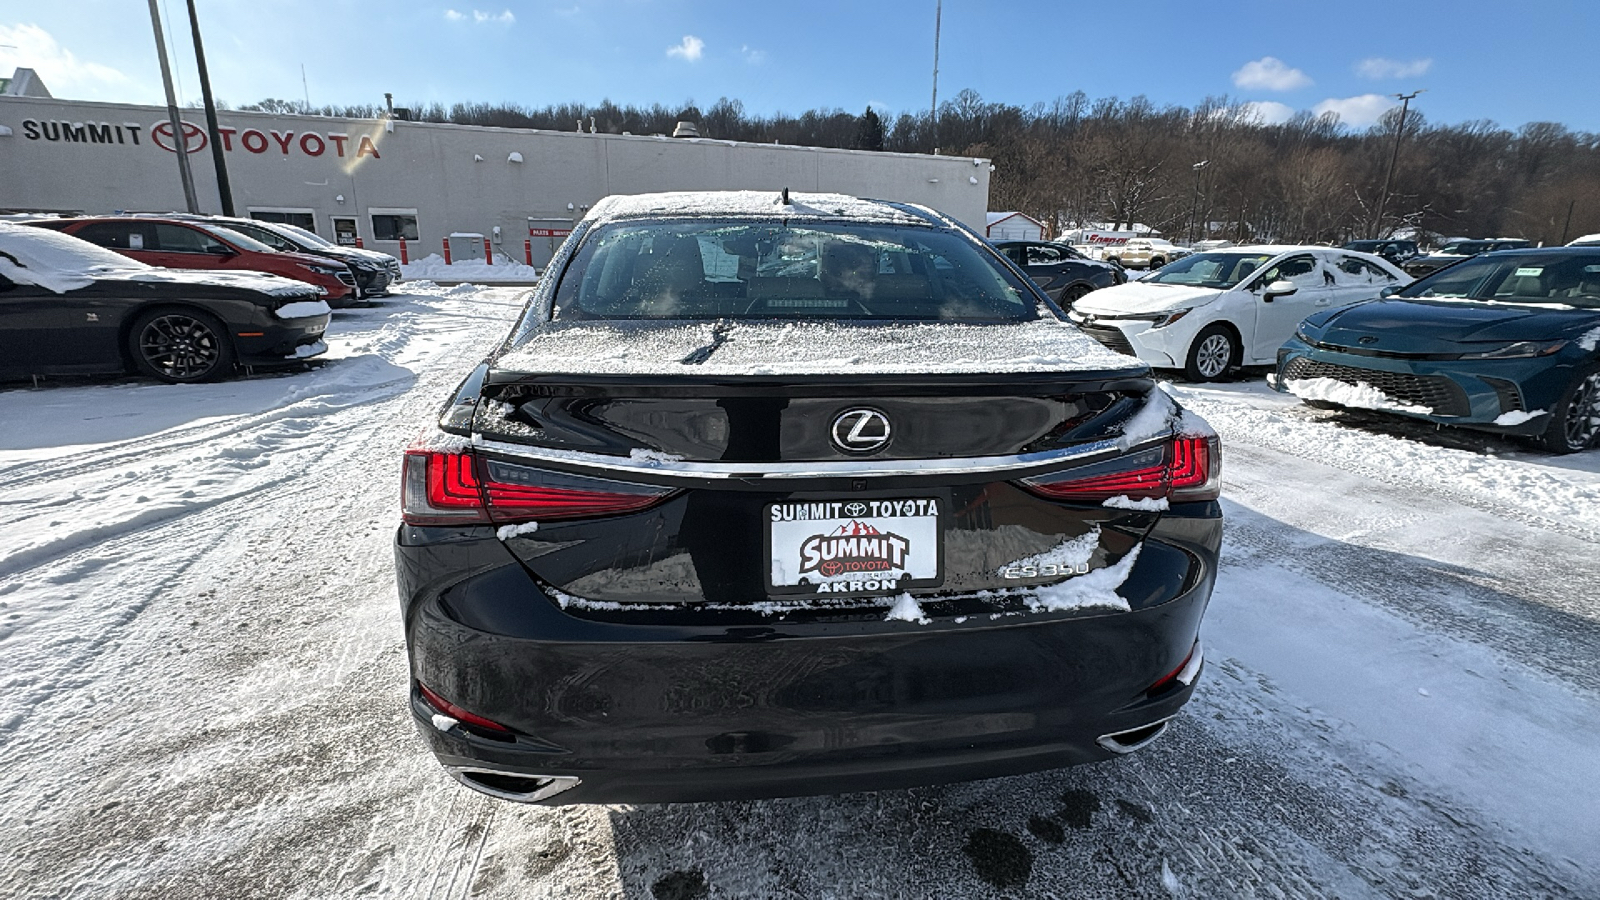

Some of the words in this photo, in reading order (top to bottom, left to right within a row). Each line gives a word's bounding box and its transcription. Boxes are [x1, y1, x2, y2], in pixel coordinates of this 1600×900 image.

[22, 119, 141, 145] SUMMIT
[218, 128, 380, 159] TOYOTA
[771, 502, 843, 521] SUMMIT
[869, 500, 939, 518] TOYOTA
[803, 536, 906, 570] SUMMIT
[844, 561, 890, 571] TOYOTA
[1005, 566, 1038, 579] ES
[1043, 562, 1089, 576] 350
[817, 579, 897, 593] AKRON
